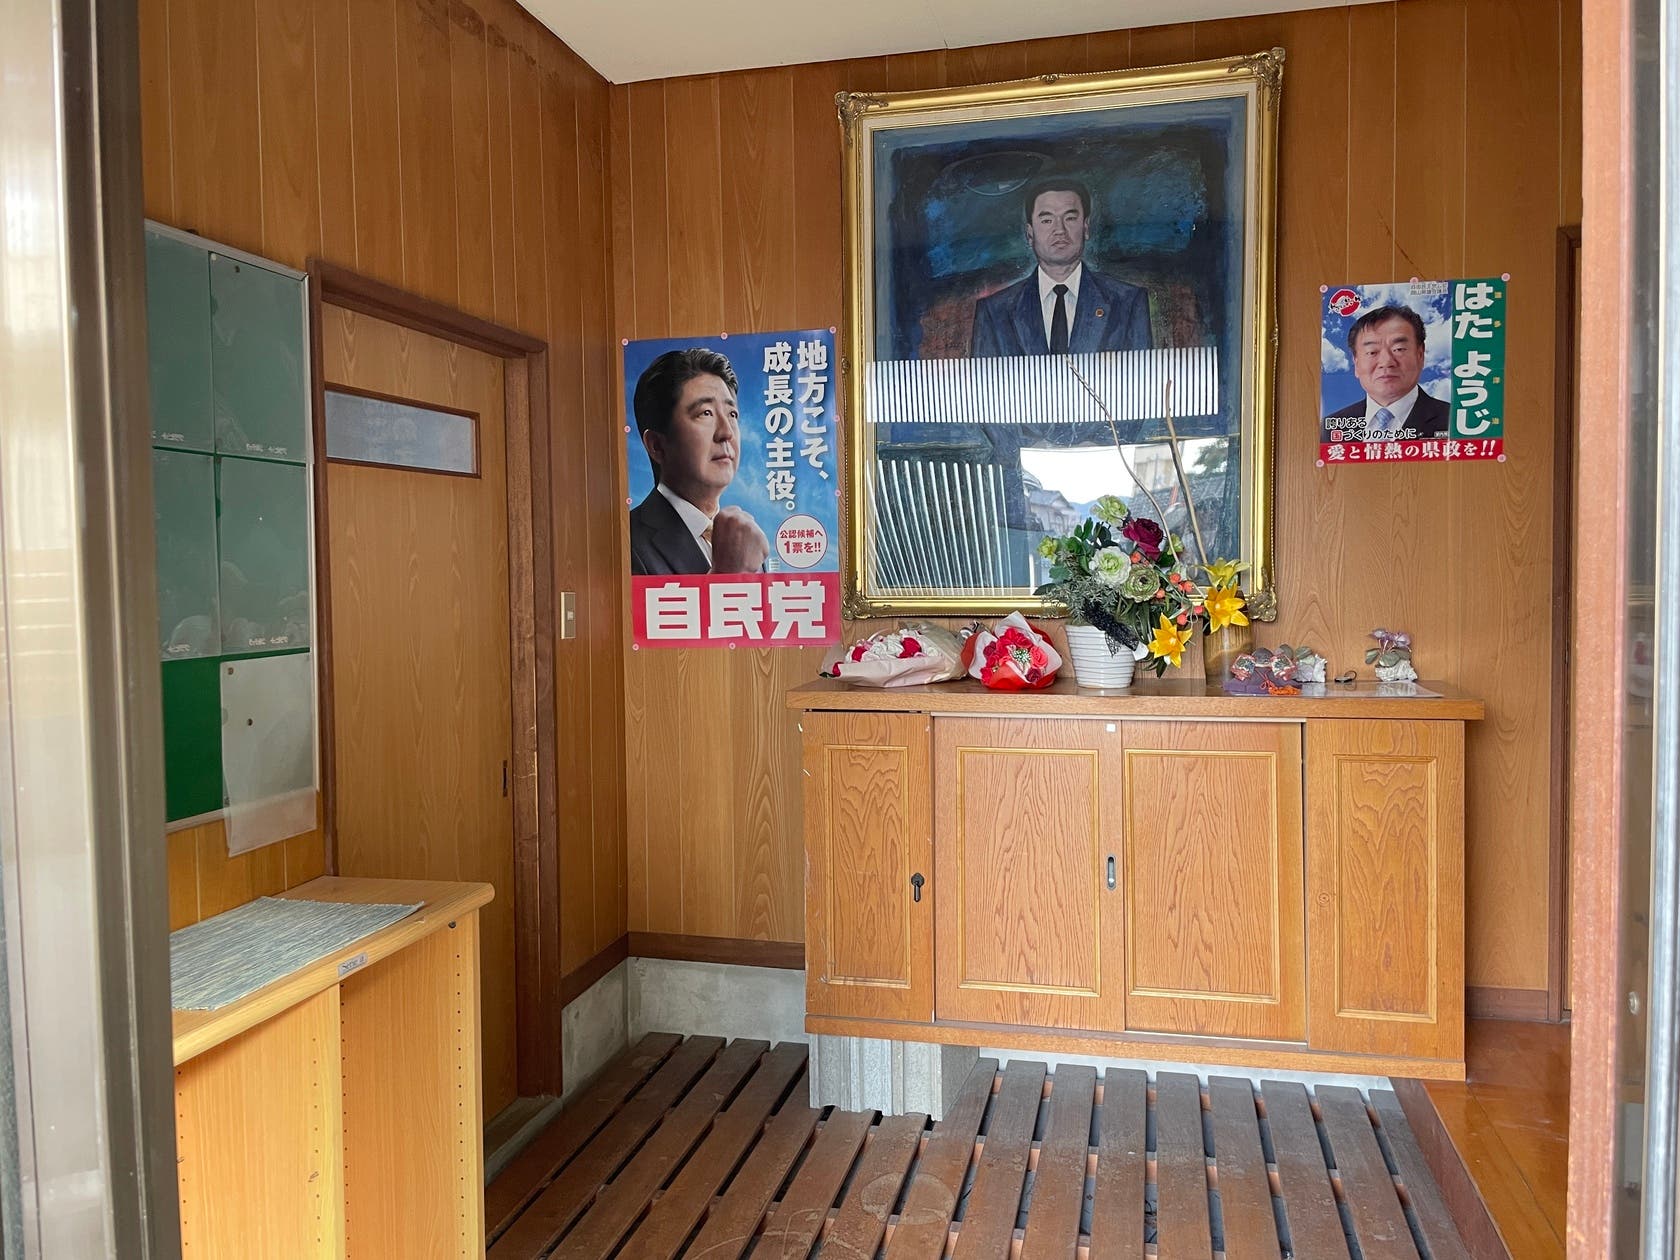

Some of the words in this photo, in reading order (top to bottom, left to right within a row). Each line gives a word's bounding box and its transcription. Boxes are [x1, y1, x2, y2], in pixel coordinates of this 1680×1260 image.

[1454, 283, 1494, 339] はた
[797, 340, 829, 480] 地方こそ、
[1454, 351, 1492, 436] ようじ
[763, 341, 796, 511] 成長の主役。
[779, 529, 824, 539] 公認候補へ
[784, 541, 821, 554] 1票を!!
[645, 580, 826, 640] 自民党
